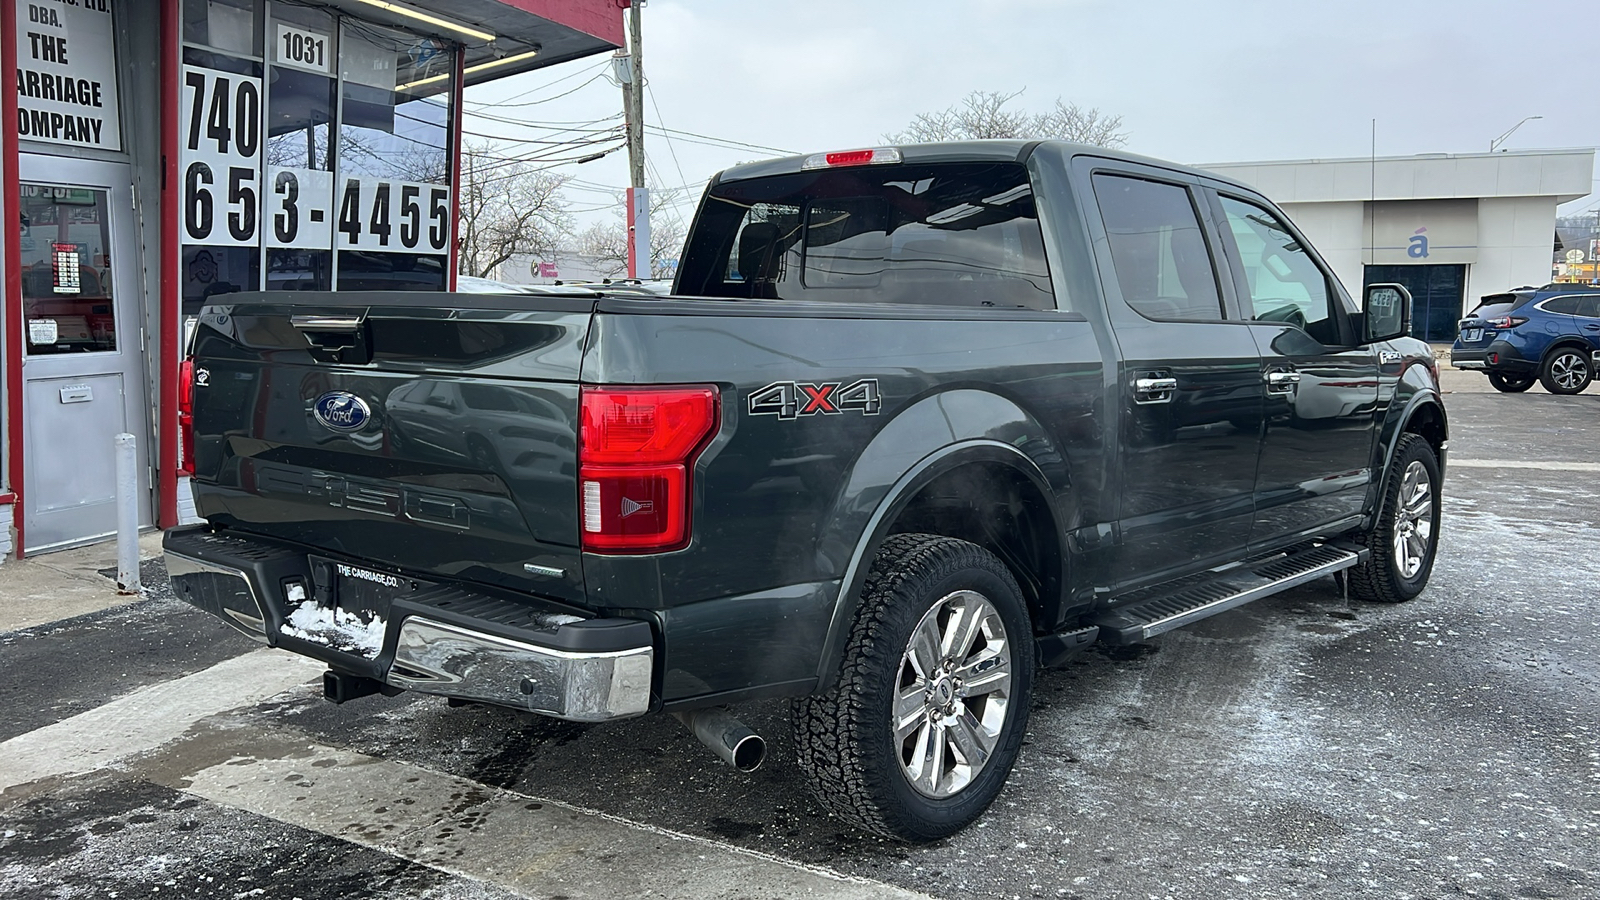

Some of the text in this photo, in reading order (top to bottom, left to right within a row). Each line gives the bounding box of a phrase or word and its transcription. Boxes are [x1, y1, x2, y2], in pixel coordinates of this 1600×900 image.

[29, 4, 62, 28] DBA.
[28, 32, 68, 65] THE
[283, 31, 324, 67] 1031
[17, 69, 102, 107] ARRIAGE
[18, 108, 102, 144] OMPANY
[186, 71, 258, 158] 740
[324, 399, 354, 423] Ford
[337, 563, 351, 577] THE
[352, 567, 385, 584] CARRIAGE
